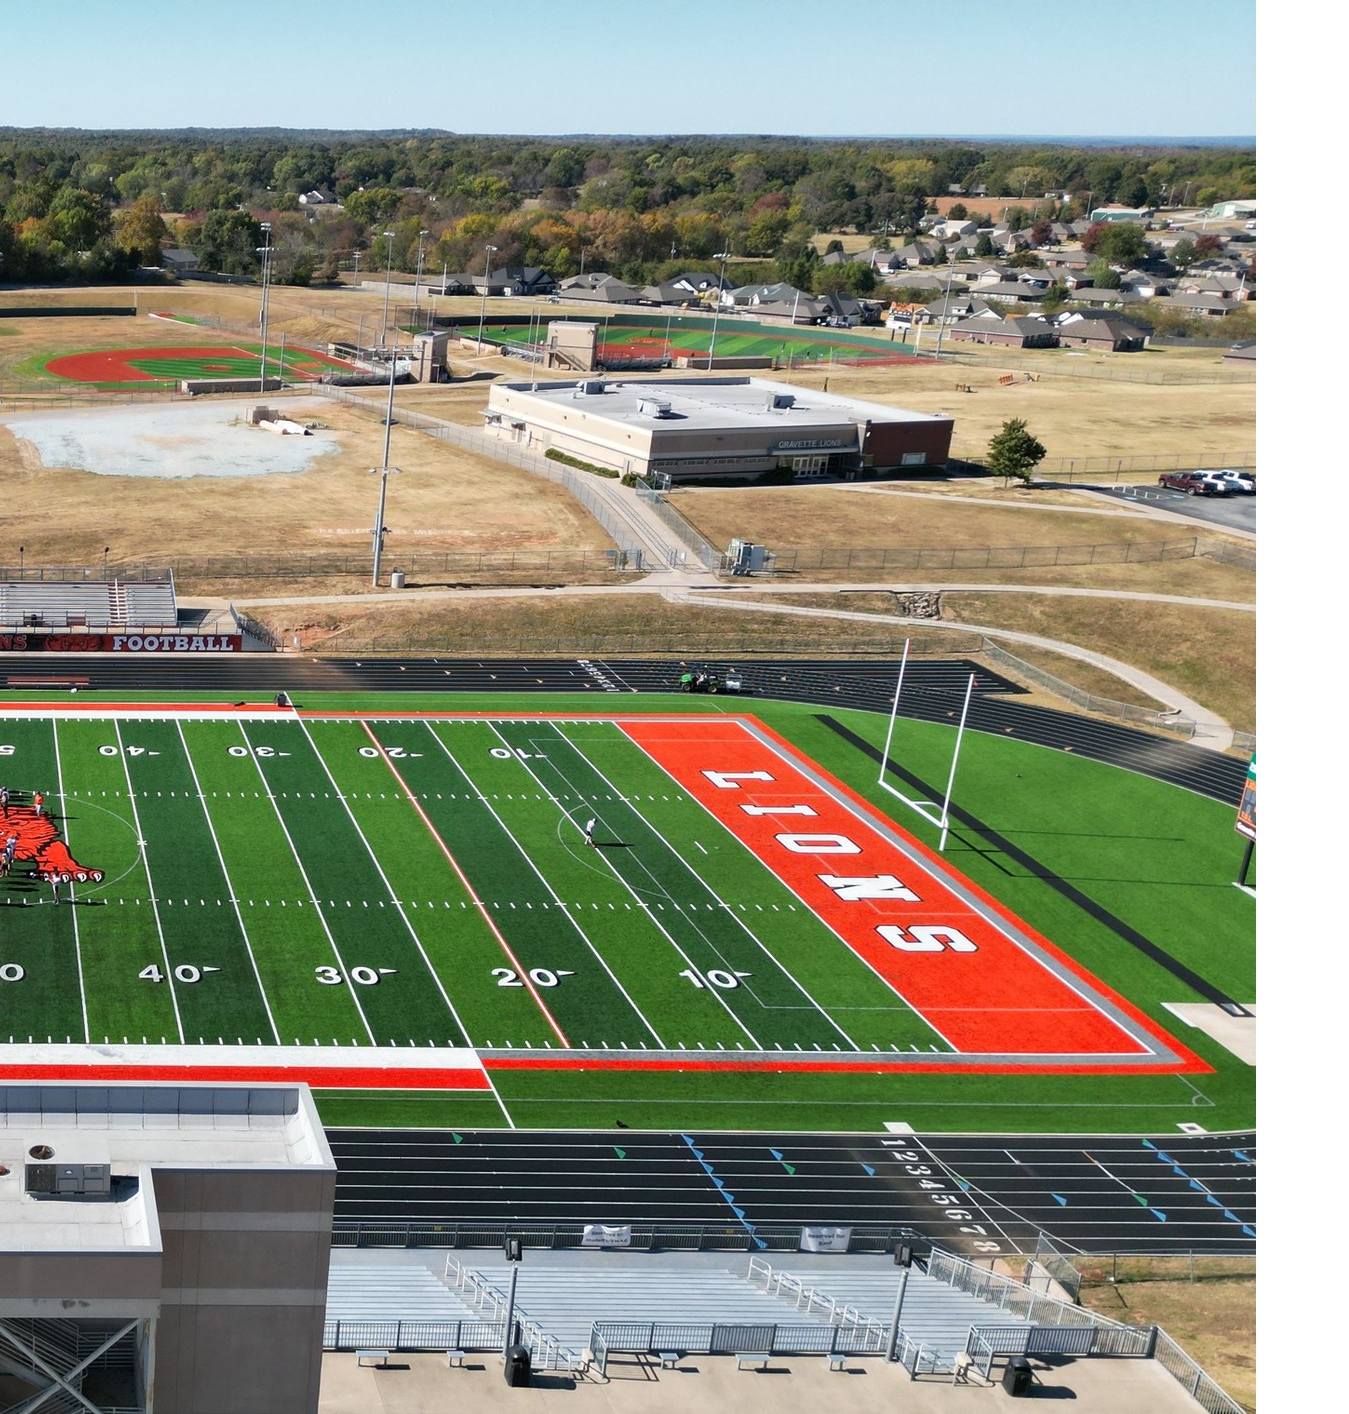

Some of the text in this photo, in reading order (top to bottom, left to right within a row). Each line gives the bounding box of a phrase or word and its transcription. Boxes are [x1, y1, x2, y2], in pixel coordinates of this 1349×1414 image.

[778, 439, 841, 448] GRAVETTE LIONS
[113, 636, 234, 651] FOOTBALL
[701, 769, 980, 953] LIONS
[138, 964, 201, 983] 40
[314, 966, 379, 985] 30
[491, 968, 559, 987] 20
[679, 969, 738, 988] 10
[892, 1151, 919, 1161] 2
[905, 1165, 931, 1175] 3
[919, 1179, 945, 1189] 4
[931, 1194, 960, 1205] 5
[945, 1209, 972, 1220] 6
[959, 1225, 987, 1235] 7
[973, 1241, 1000, 1252] 8
